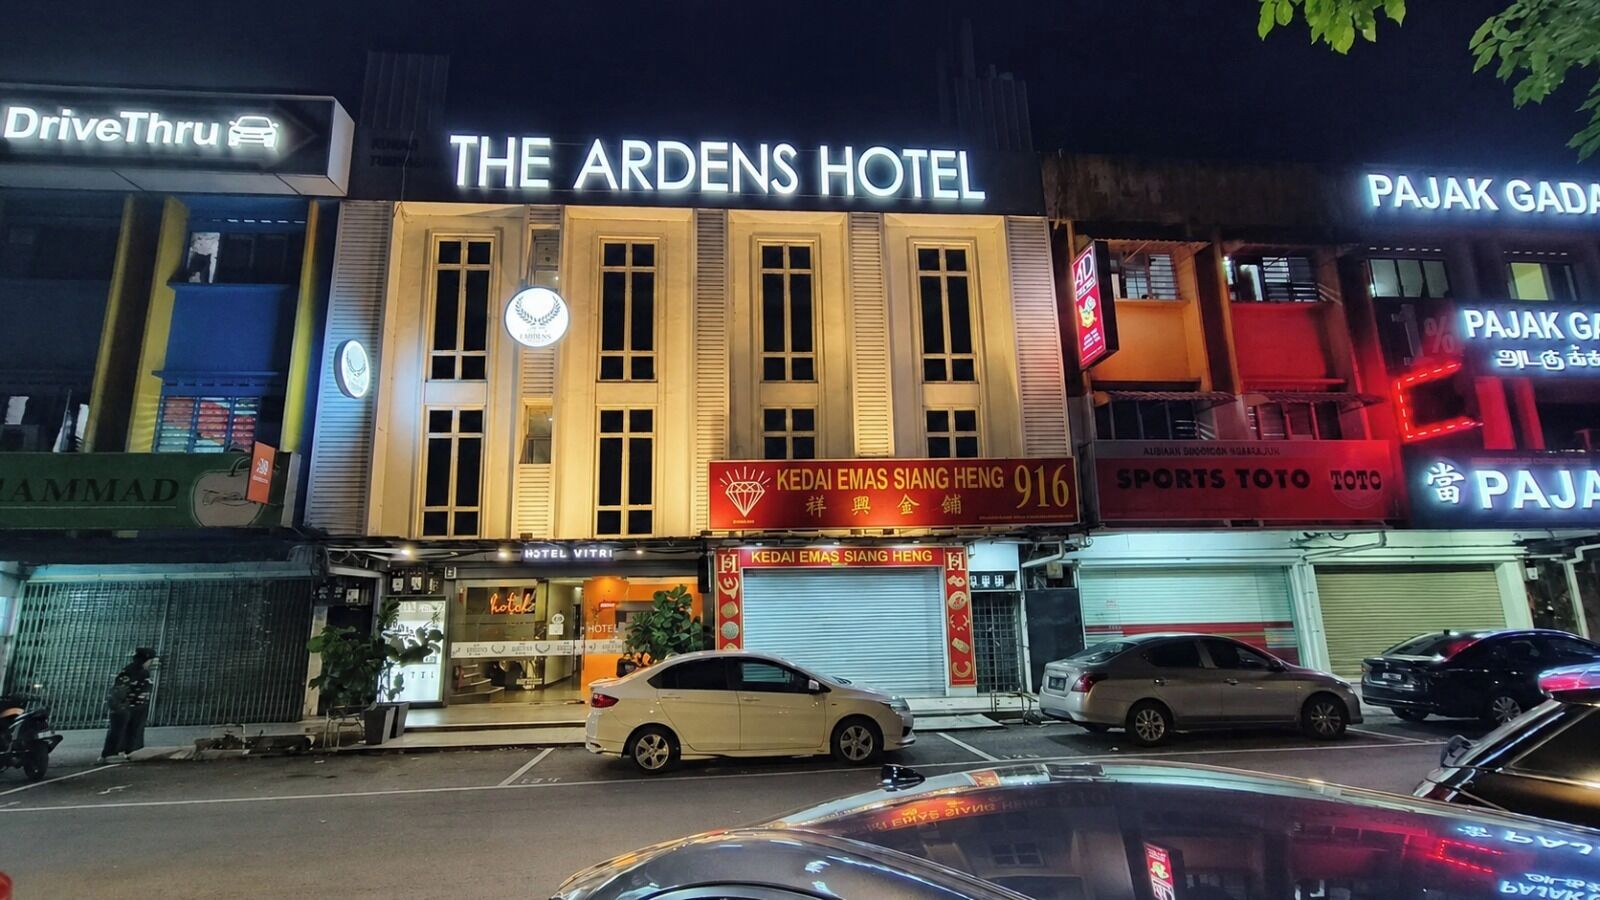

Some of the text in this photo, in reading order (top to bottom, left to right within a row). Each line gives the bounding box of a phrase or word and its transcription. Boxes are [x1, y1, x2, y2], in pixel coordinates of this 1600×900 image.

[4, 106, 219, 146] DriveThru
[449, 135, 987, 200] THE ARDENS HOTEL
[1367, 174, 1499, 211] PAJAK
[1463, 309, 1565, 339] PAJAK
[0, 477, 179, 502] AMMAD
[776, 465, 1005, 491] KEDAI EMAS SIANG HENG
[1013, 464, 1070, 509] 916
[1116, 467, 1311, 490] SPORTS TOTO
[1330, 469, 1383, 491] TOTO
[524, 549, 613, 558] HOTEL VITRI
[751, 549, 933, 563] KEDAI EMAS SIANG HENG
[588, 623, 619, 633] HOTEL
